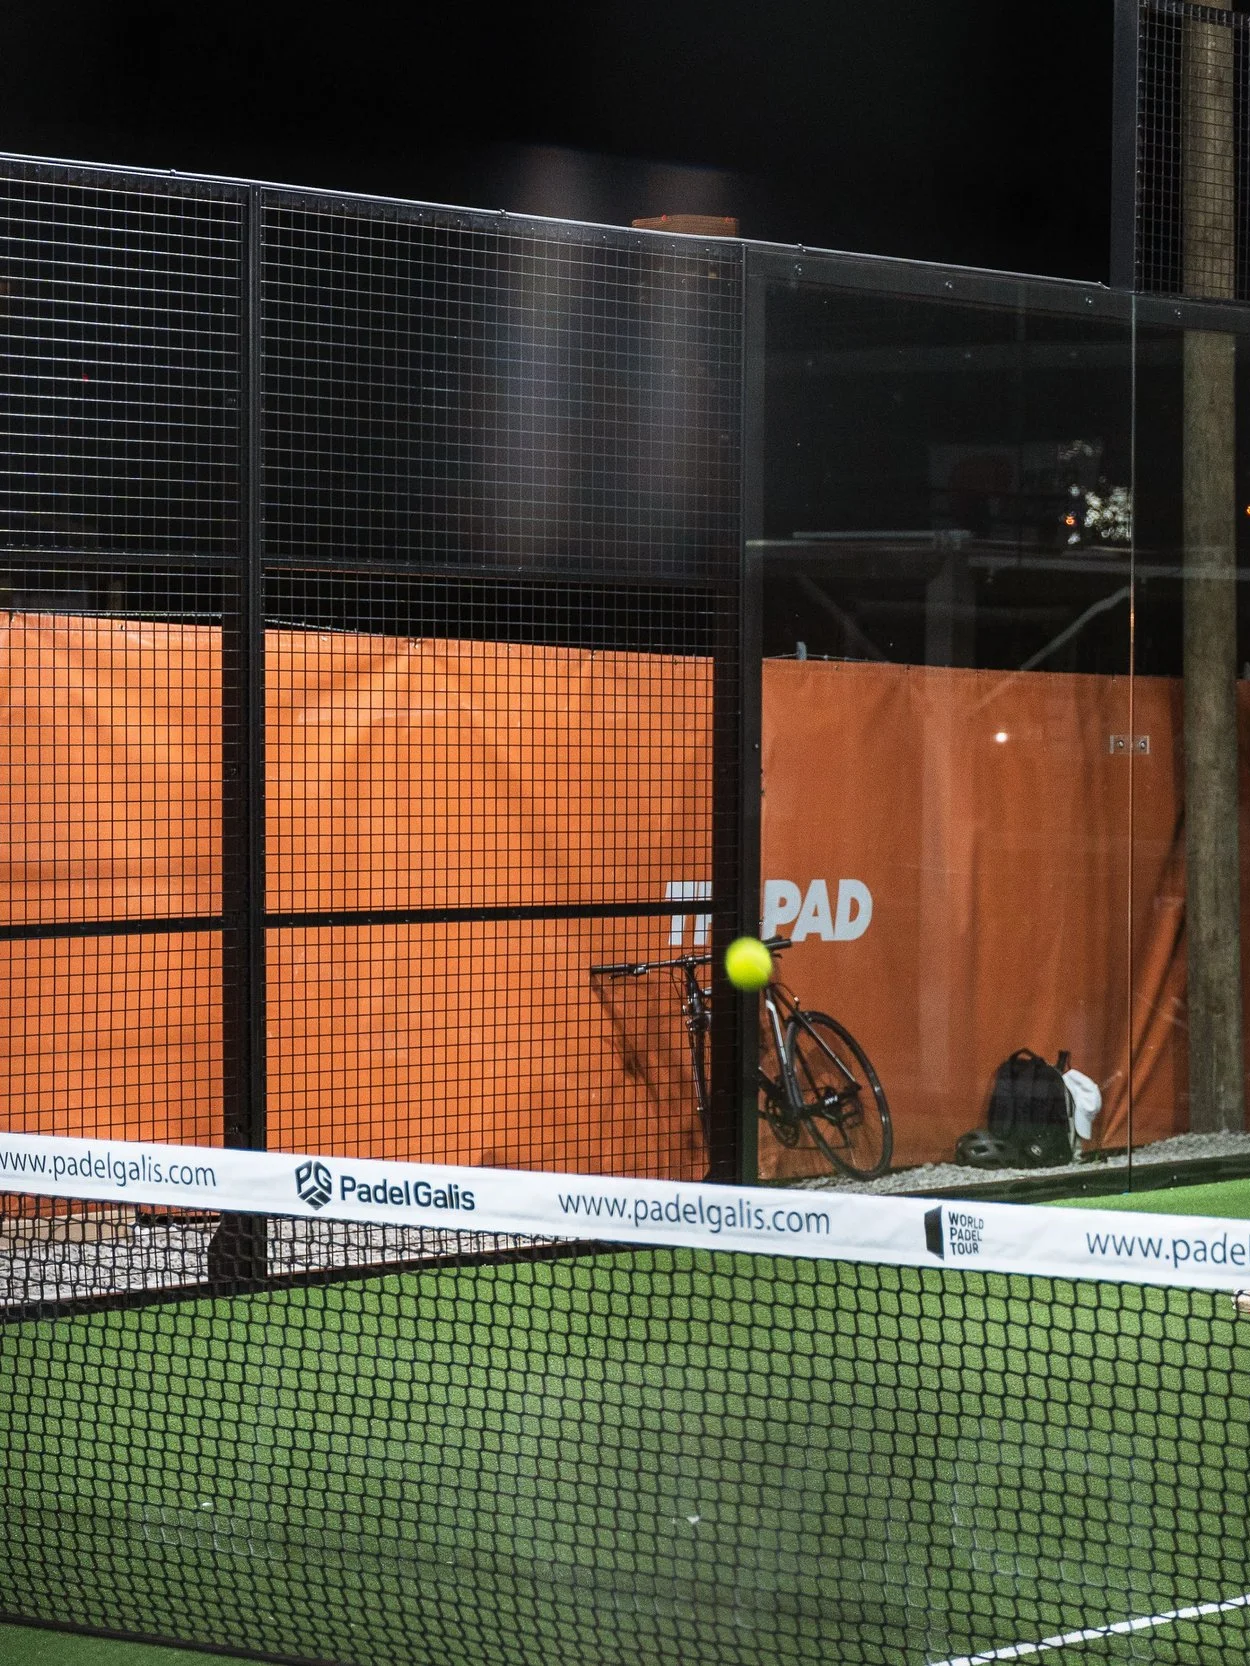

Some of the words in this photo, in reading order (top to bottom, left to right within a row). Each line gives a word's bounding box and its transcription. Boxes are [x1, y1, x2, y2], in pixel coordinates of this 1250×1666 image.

[760, 879, 873, 942] PAD
[558, 1193, 830, 1235] www.padelgalis.com
[948, 1211, 984, 1230] WORLD
[950, 1227, 982, 1241] PADEL
[950, 1242, 979, 1255] TOUR
